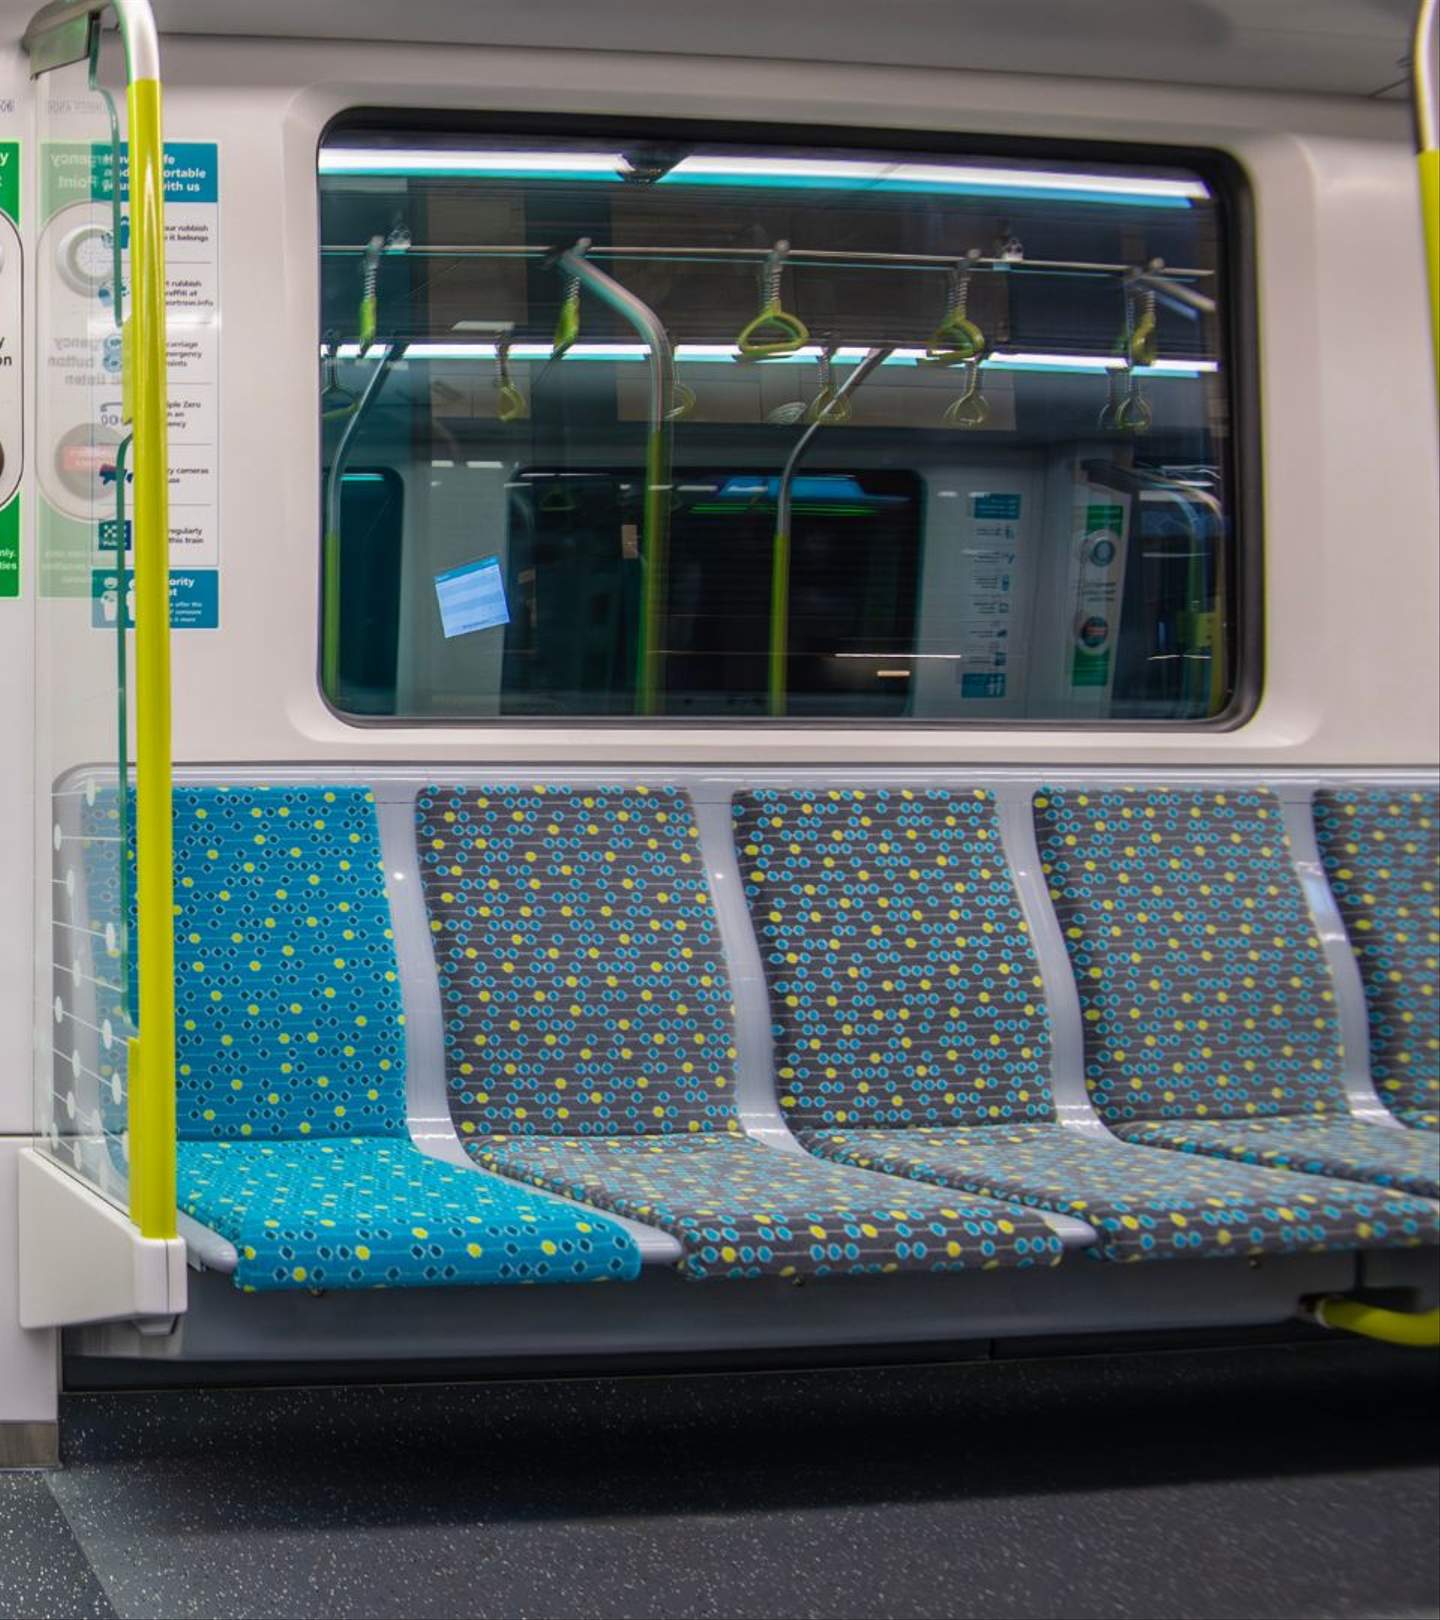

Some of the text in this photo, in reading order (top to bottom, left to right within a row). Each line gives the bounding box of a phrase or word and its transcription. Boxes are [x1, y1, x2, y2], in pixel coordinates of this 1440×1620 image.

[162, 168, 206, 179] ortable
[187, 183, 200, 192] us
[169, 578, 195, 588] ority
